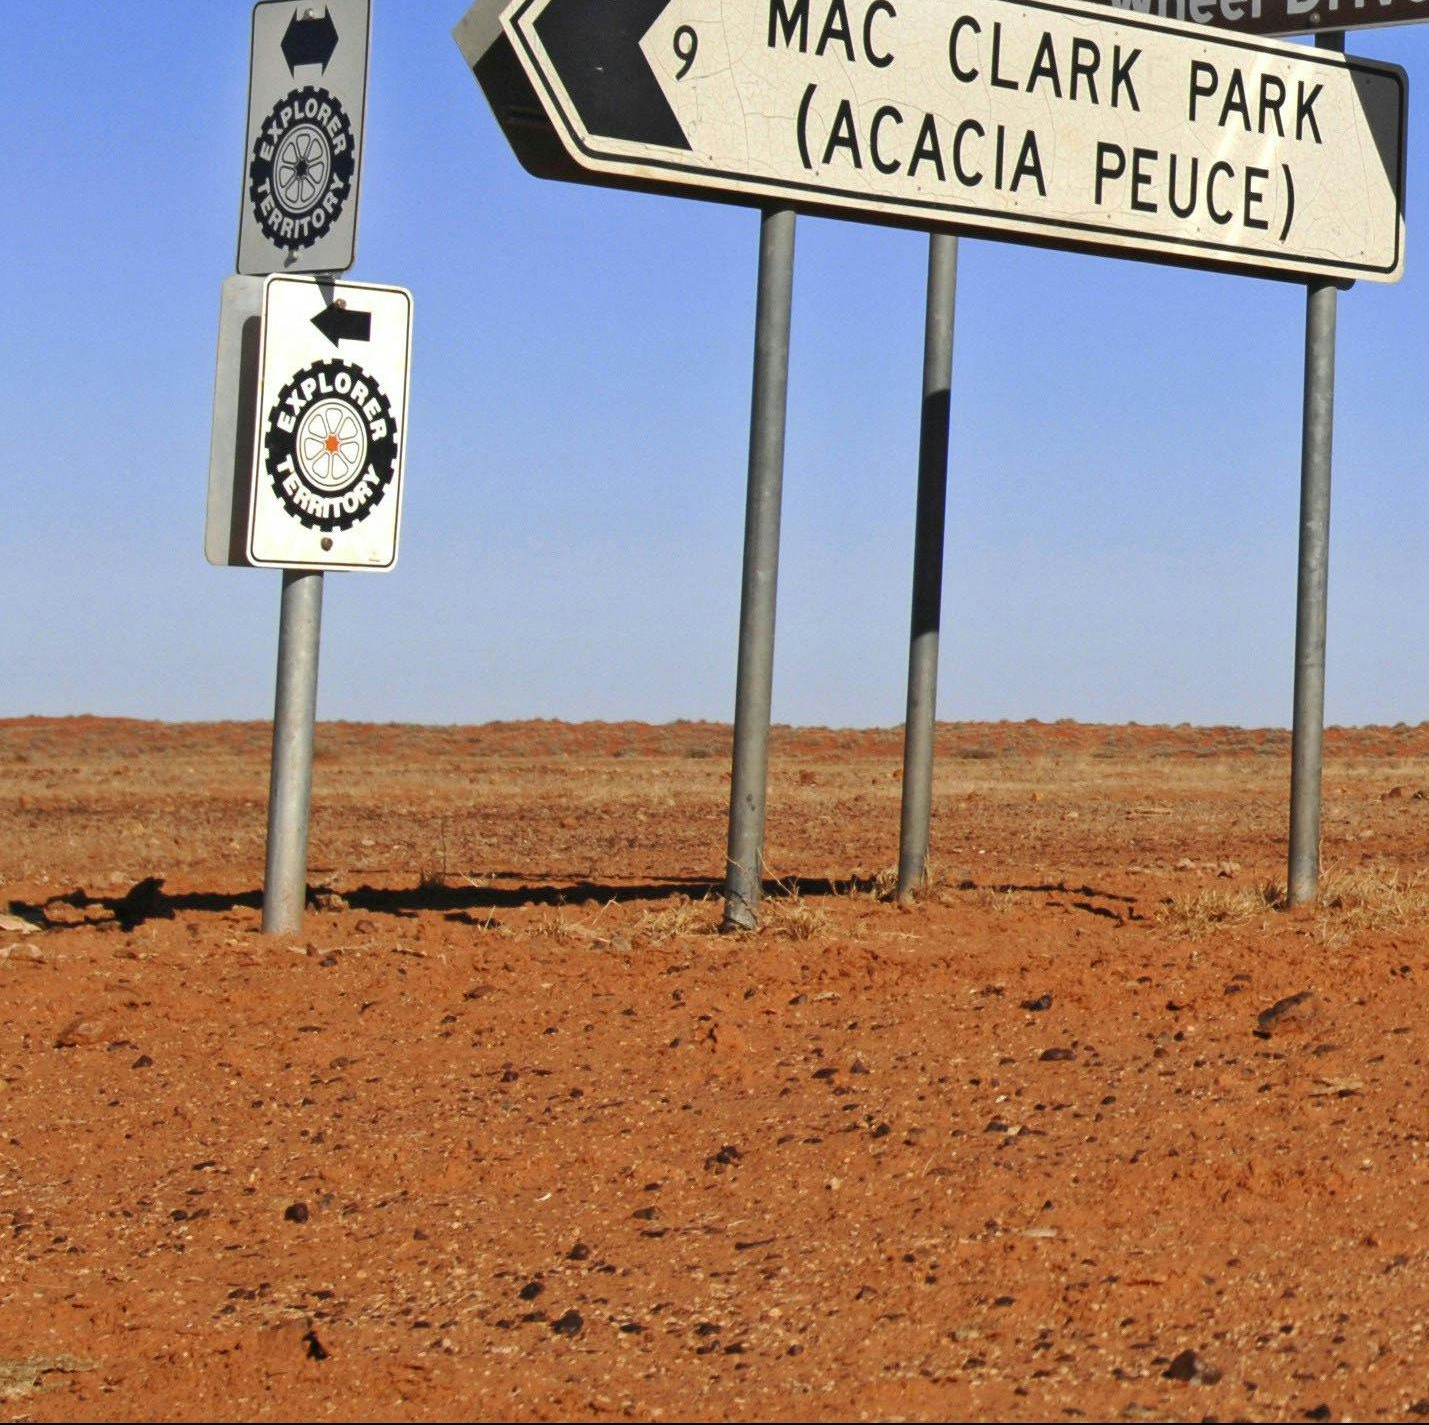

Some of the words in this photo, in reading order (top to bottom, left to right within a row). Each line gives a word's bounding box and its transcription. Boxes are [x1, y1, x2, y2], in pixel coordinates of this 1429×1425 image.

[673, 24, 699, 80] 9
[948, 14, 1143, 113] CLARK
[1188, 61, 1324, 146] PARK
[259, 97, 347, 162] EXPLORER
[797, 82, 1047, 198] (ACACIA
[1094, 141, 1298, 241] PEUCE)
[257, 172, 345, 239] TERRITORY
[276, 371, 388, 442] EXPLORER
[276, 453, 381, 519] TERRITORY
